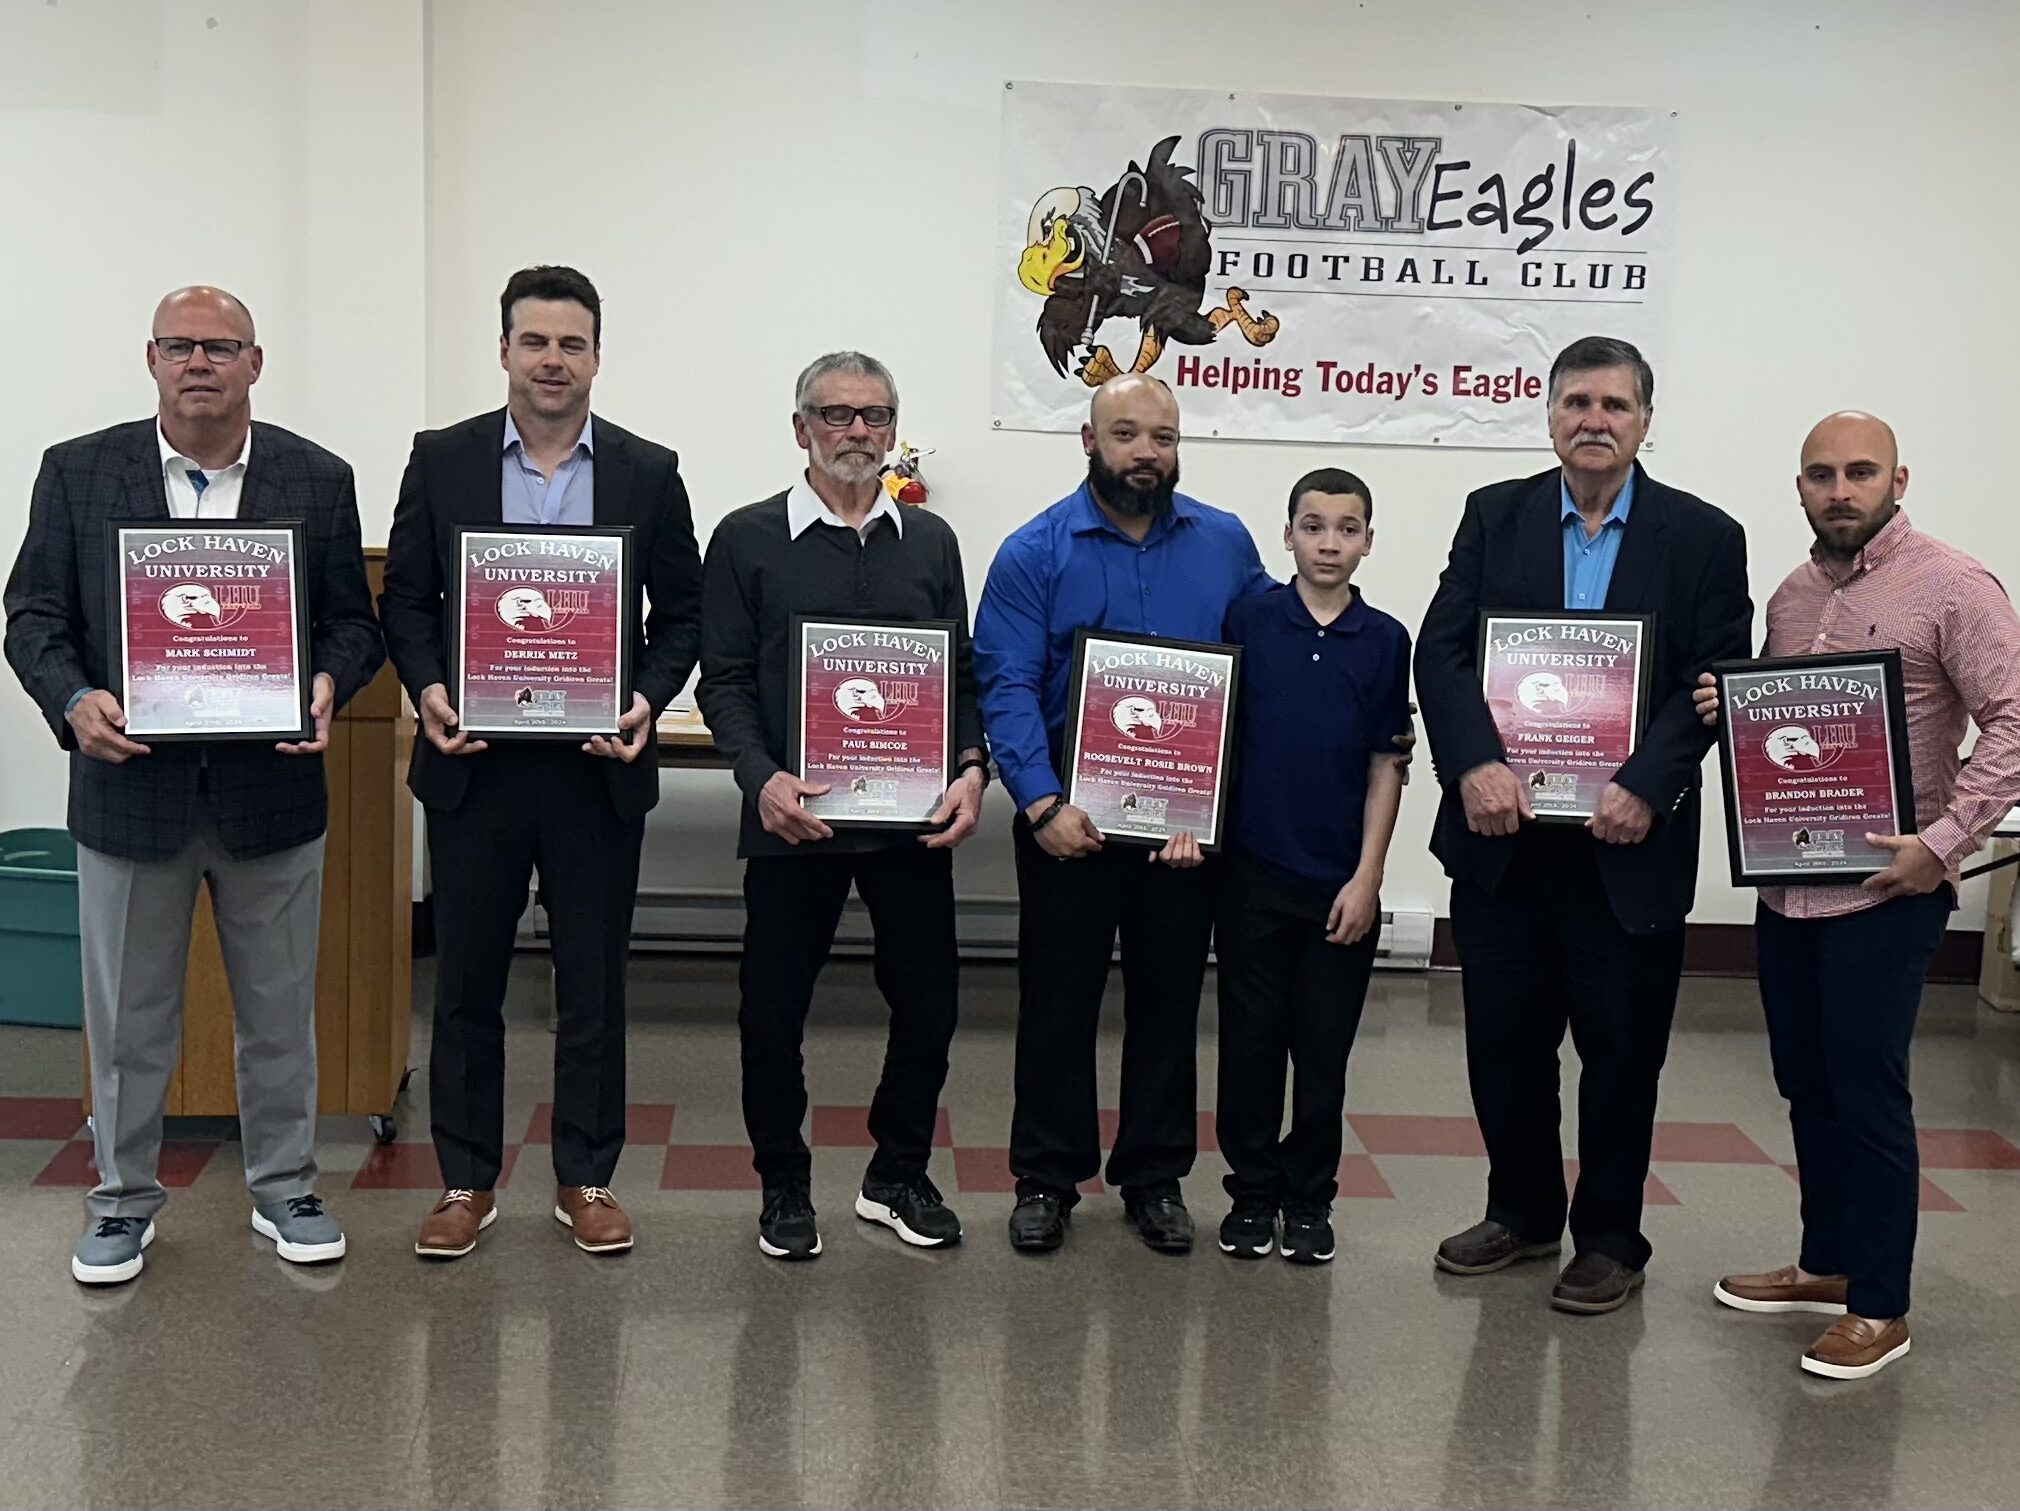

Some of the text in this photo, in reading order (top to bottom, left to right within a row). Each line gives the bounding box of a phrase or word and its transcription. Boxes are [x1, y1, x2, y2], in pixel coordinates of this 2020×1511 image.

[1195, 128, 1655, 255] GRAY Eagles
[1216, 250, 1647, 290] FOOTBALL CLUB
[1177, 355, 1304, 397] Helping
[1317, 361, 1439, 401] Today's
[127, 535, 286, 565] LOCK HAVEN
[469, 541, 616, 572] LOCK HAVEN
[145, 564, 271, 578] UNIVERSITY
[484, 568, 600, 583] UNIVERSITY
[172, 634, 238, 643] Congratulations
[506, 636, 567, 646] Congratulations
[1493, 625, 1635, 656] LOCK HAVEN
[165, 648, 257, 658] MARK SCHMIDT
[503, 650, 579, 660] DERRIK METZ
[808, 632, 943, 664] LOCK HAVEN
[823, 658, 929, 676] UNIVERSITY
[1506, 653, 1618, 668] UNIVERSITY
[505, 665, 522, 674] your
[1091, 652, 1225, 688] LOCK HAVEN
[1103, 674, 1210, 699] UNIVERSITY
[1732, 675, 1881, 710] LOCK HAVEN
[1748, 701, 1865, 722] UNIVERSITY
[842, 726, 899, 736] Congratulations
[1517, 733, 1595, 744] FRANK GEIGER
[842, 740, 908, 751] PAUL SIMCOE
[1083, 751, 1214, 774] ROOSEVELT ROSIE BROWN
[1777, 775, 1848, 785] Congratulations to
[1764, 788, 1865, 801] BRANDON BRADER
[1764, 806, 1778, 814] For
[1779, 806, 1797, 815] your
[1853, 803, 1867, 811] the
[1744, 817, 1762, 825] Lock
